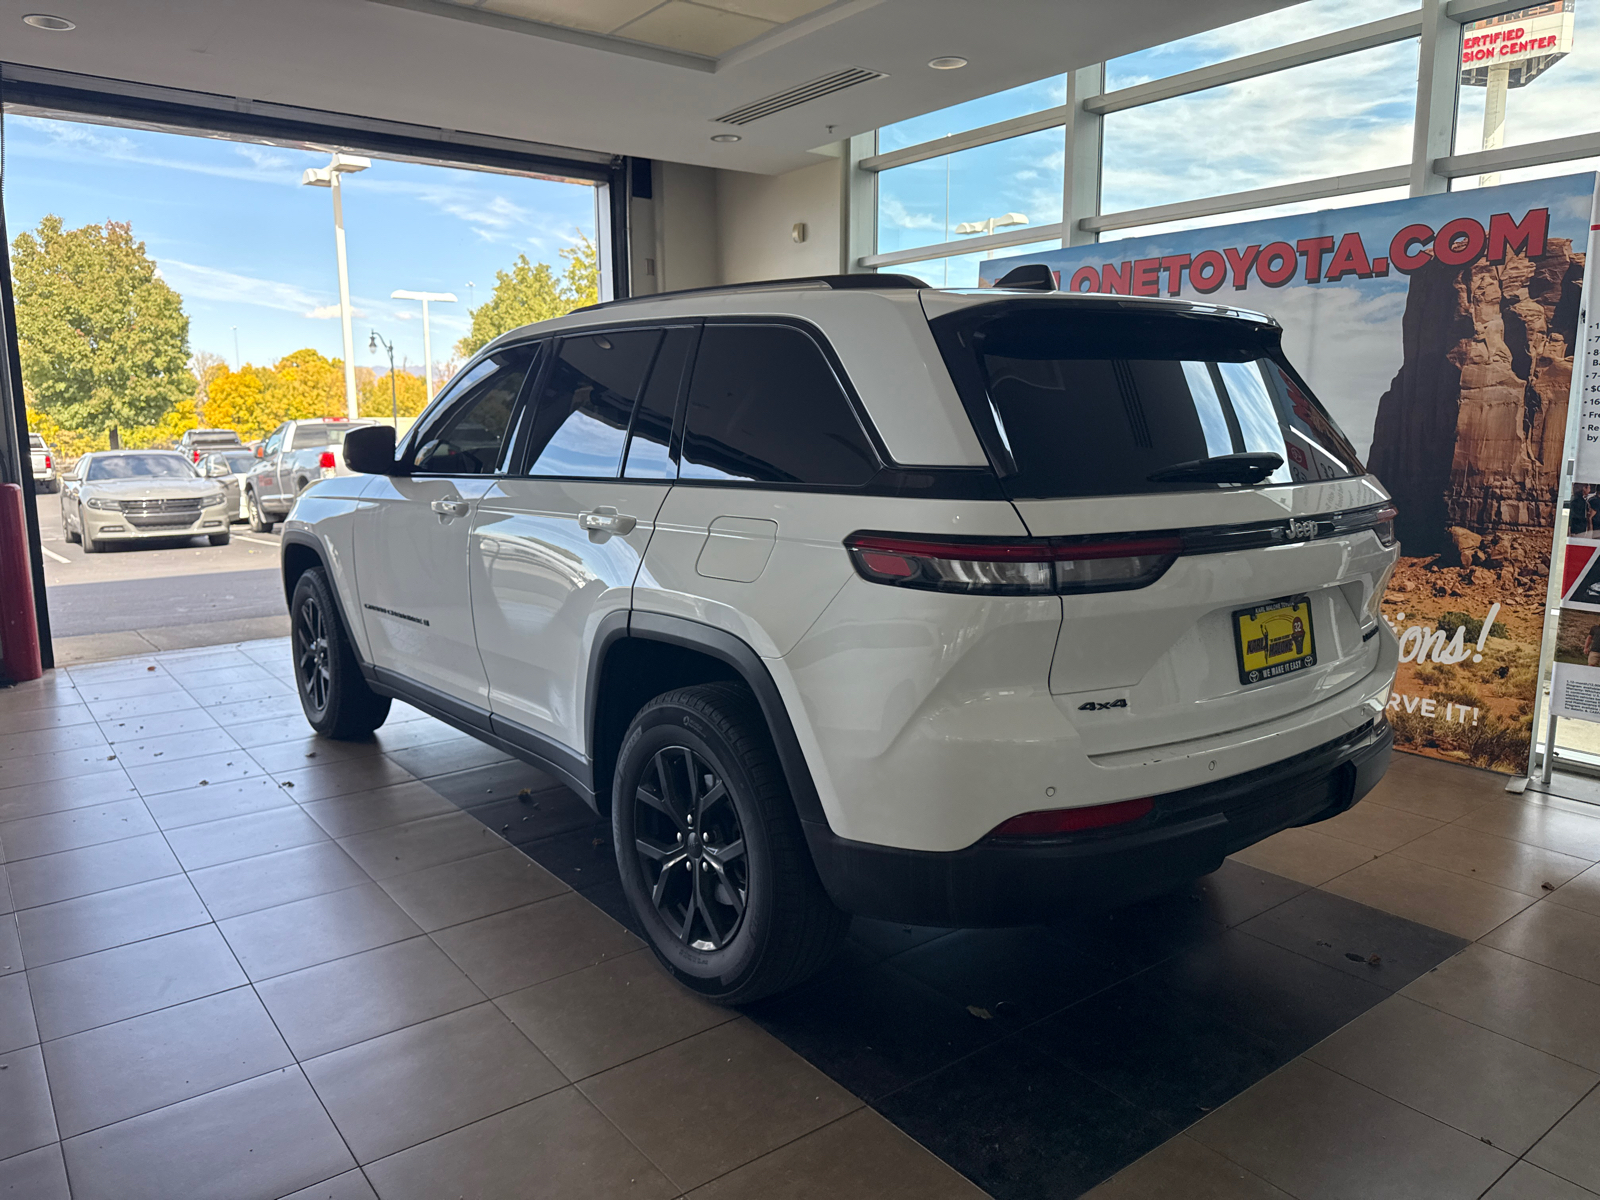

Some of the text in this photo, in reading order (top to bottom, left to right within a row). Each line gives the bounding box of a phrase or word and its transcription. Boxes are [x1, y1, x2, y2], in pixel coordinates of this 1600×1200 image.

[1462, 35, 1557, 63] SION CENTER
[1463, 28, 1524, 50] ERTIFIED
[1586, 433, 1599, 443] by
[1286, 518, 1319, 540] Jeep
[1294, 622, 1301, 631] 32
[1262, 668, 1271, 679] WE
[1271, 665, 1285, 677] MAKE
[1290, 660, 1302, 672] EASY
[1445, 702, 1479, 727] IT!
